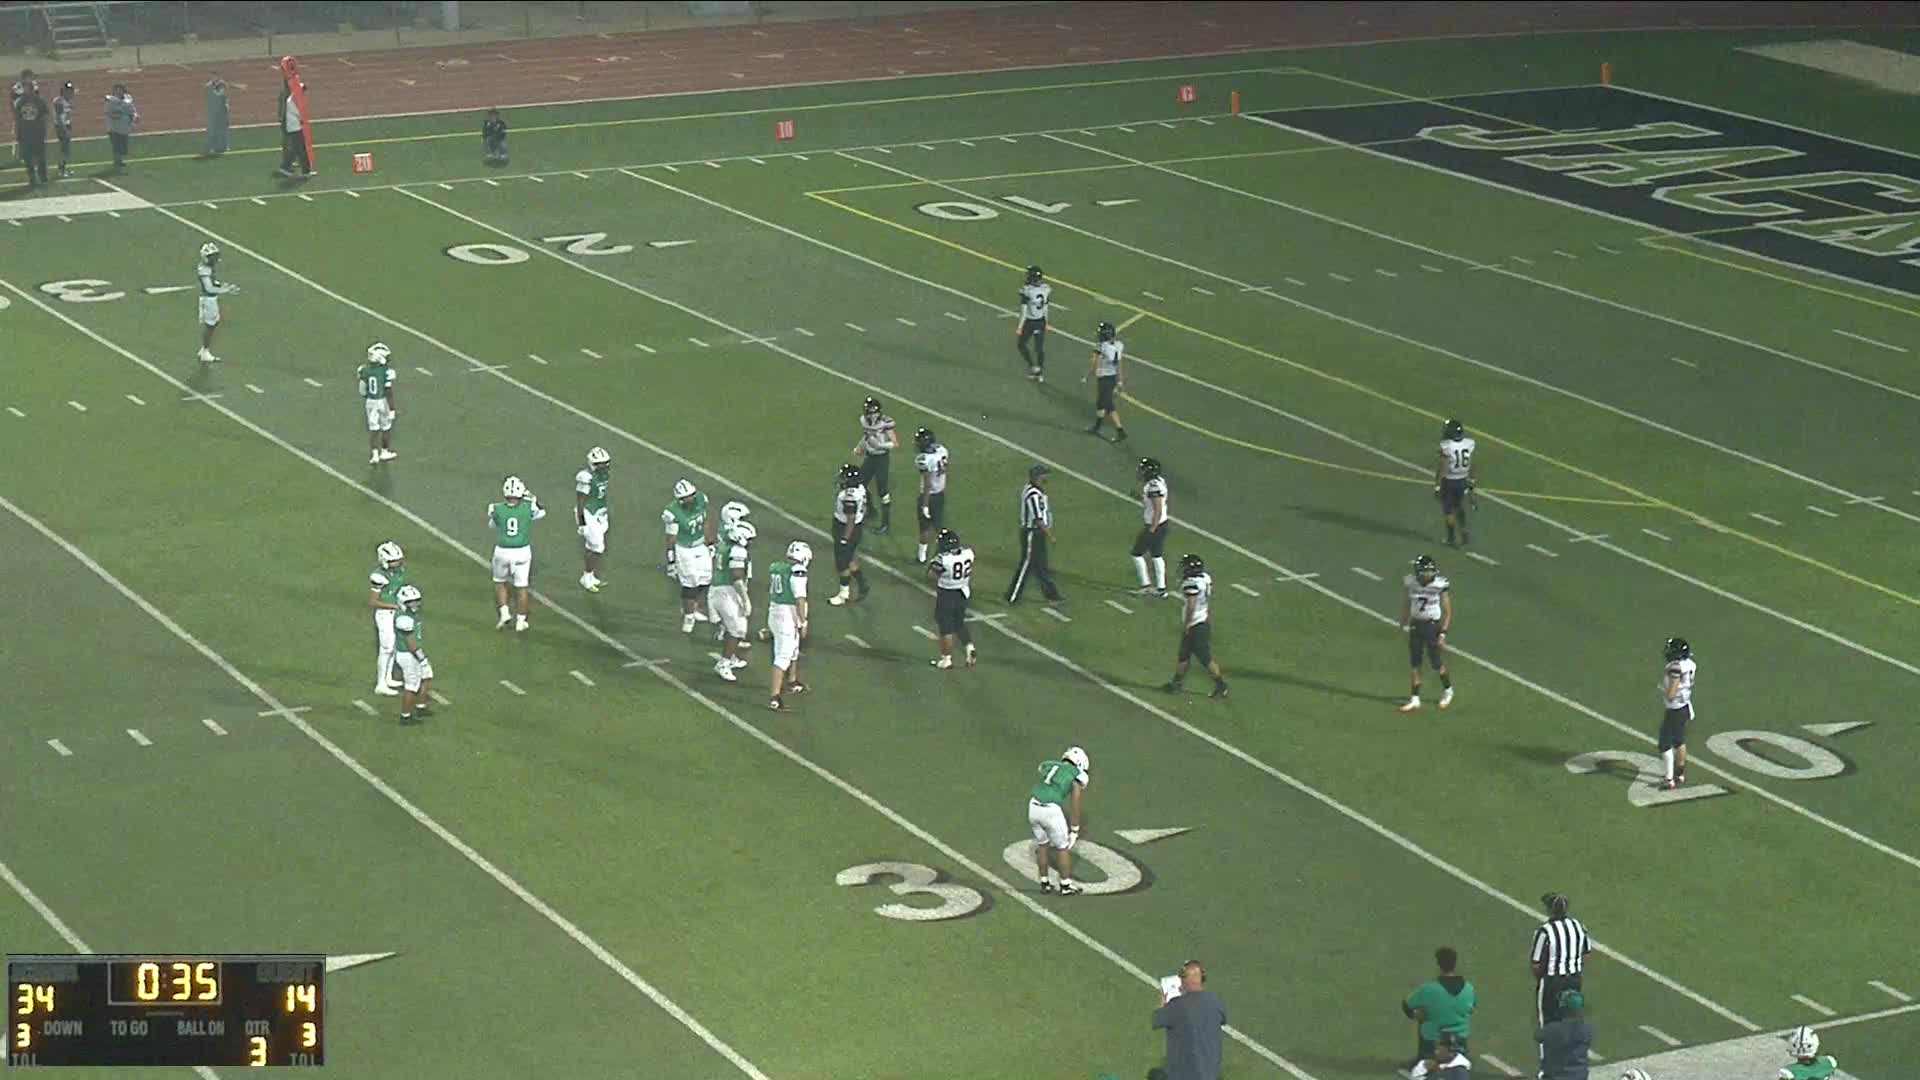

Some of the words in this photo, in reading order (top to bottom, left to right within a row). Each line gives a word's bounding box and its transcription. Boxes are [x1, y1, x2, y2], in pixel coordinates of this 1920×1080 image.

[368, 376, 378, 395] 0
[1454, 449, 1470, 469] 16
[507, 517, 518, 537] 9
[953, 559, 972, 580] 82
[1417, 597, 1428, 612] 7
[1044, 765, 1060, 785] 1
